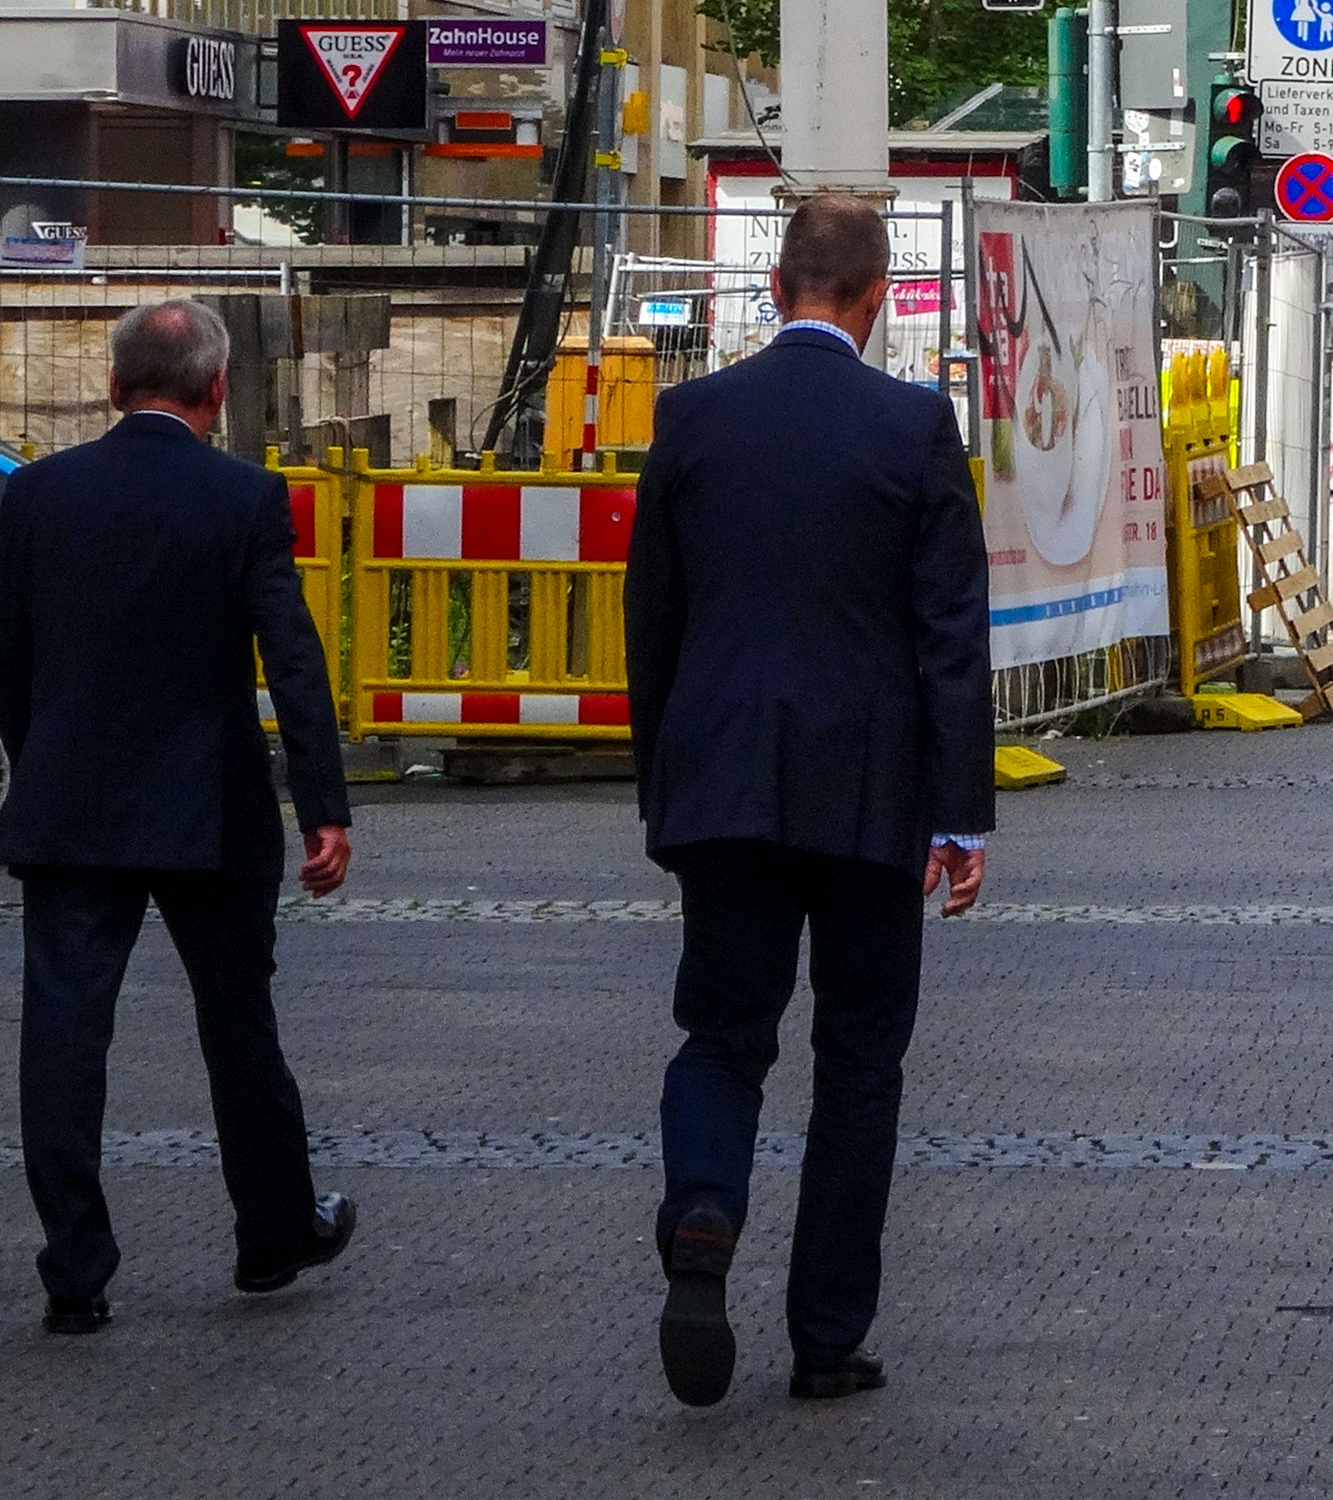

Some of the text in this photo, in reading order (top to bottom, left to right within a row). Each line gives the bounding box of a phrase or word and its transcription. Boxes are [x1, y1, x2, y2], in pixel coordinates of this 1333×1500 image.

[318, 34, 386, 52] GUESS
[430, 27, 539, 46] ZahnHouse
[186, 36, 235, 99] GUESS
[1266, 104, 1289, 115] und
[1293, 103, 1330, 116] Taxen
[1264, 121, 1304, 133] Mo-Fr
[1264, 137, 1280, 149] Sa
[1146, 521, 1157, 541] 18
